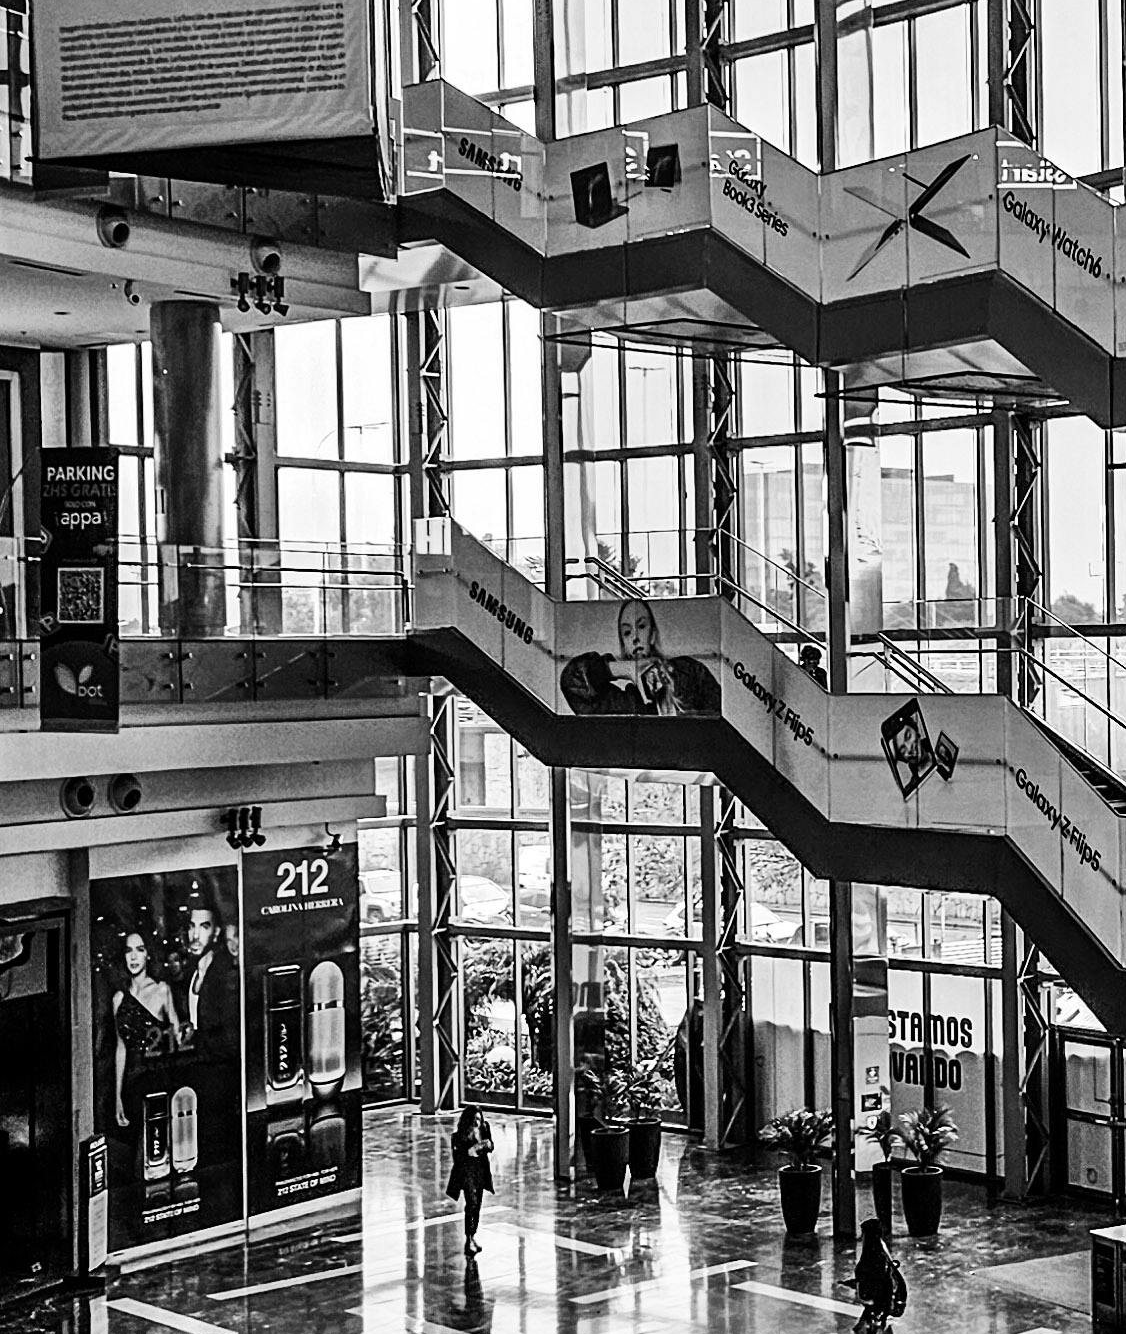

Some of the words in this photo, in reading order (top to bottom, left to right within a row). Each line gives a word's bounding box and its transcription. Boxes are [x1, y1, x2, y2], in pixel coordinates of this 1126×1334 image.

[723, 180, 755, 213] Book3
[756, 201, 789, 237] Series
[1003, 190, 1049, 243] Galaxy
[1051, 223, 1102, 278] Watch6
[47, 466, 115, 481] PARKING
[468, 579, 534, 645] SAMSUNG
[733, 661, 777, 713] Galaxy
[775, 703, 786, 722] Z
[785, 705, 814, 747] Flip5
[1015, 768, 1061, 830] Galaxy
[1069, 828, 1102, 871] Flip5
[276, 858, 329, 898] 212
[888, 1009, 972, 1049] STAMOS
